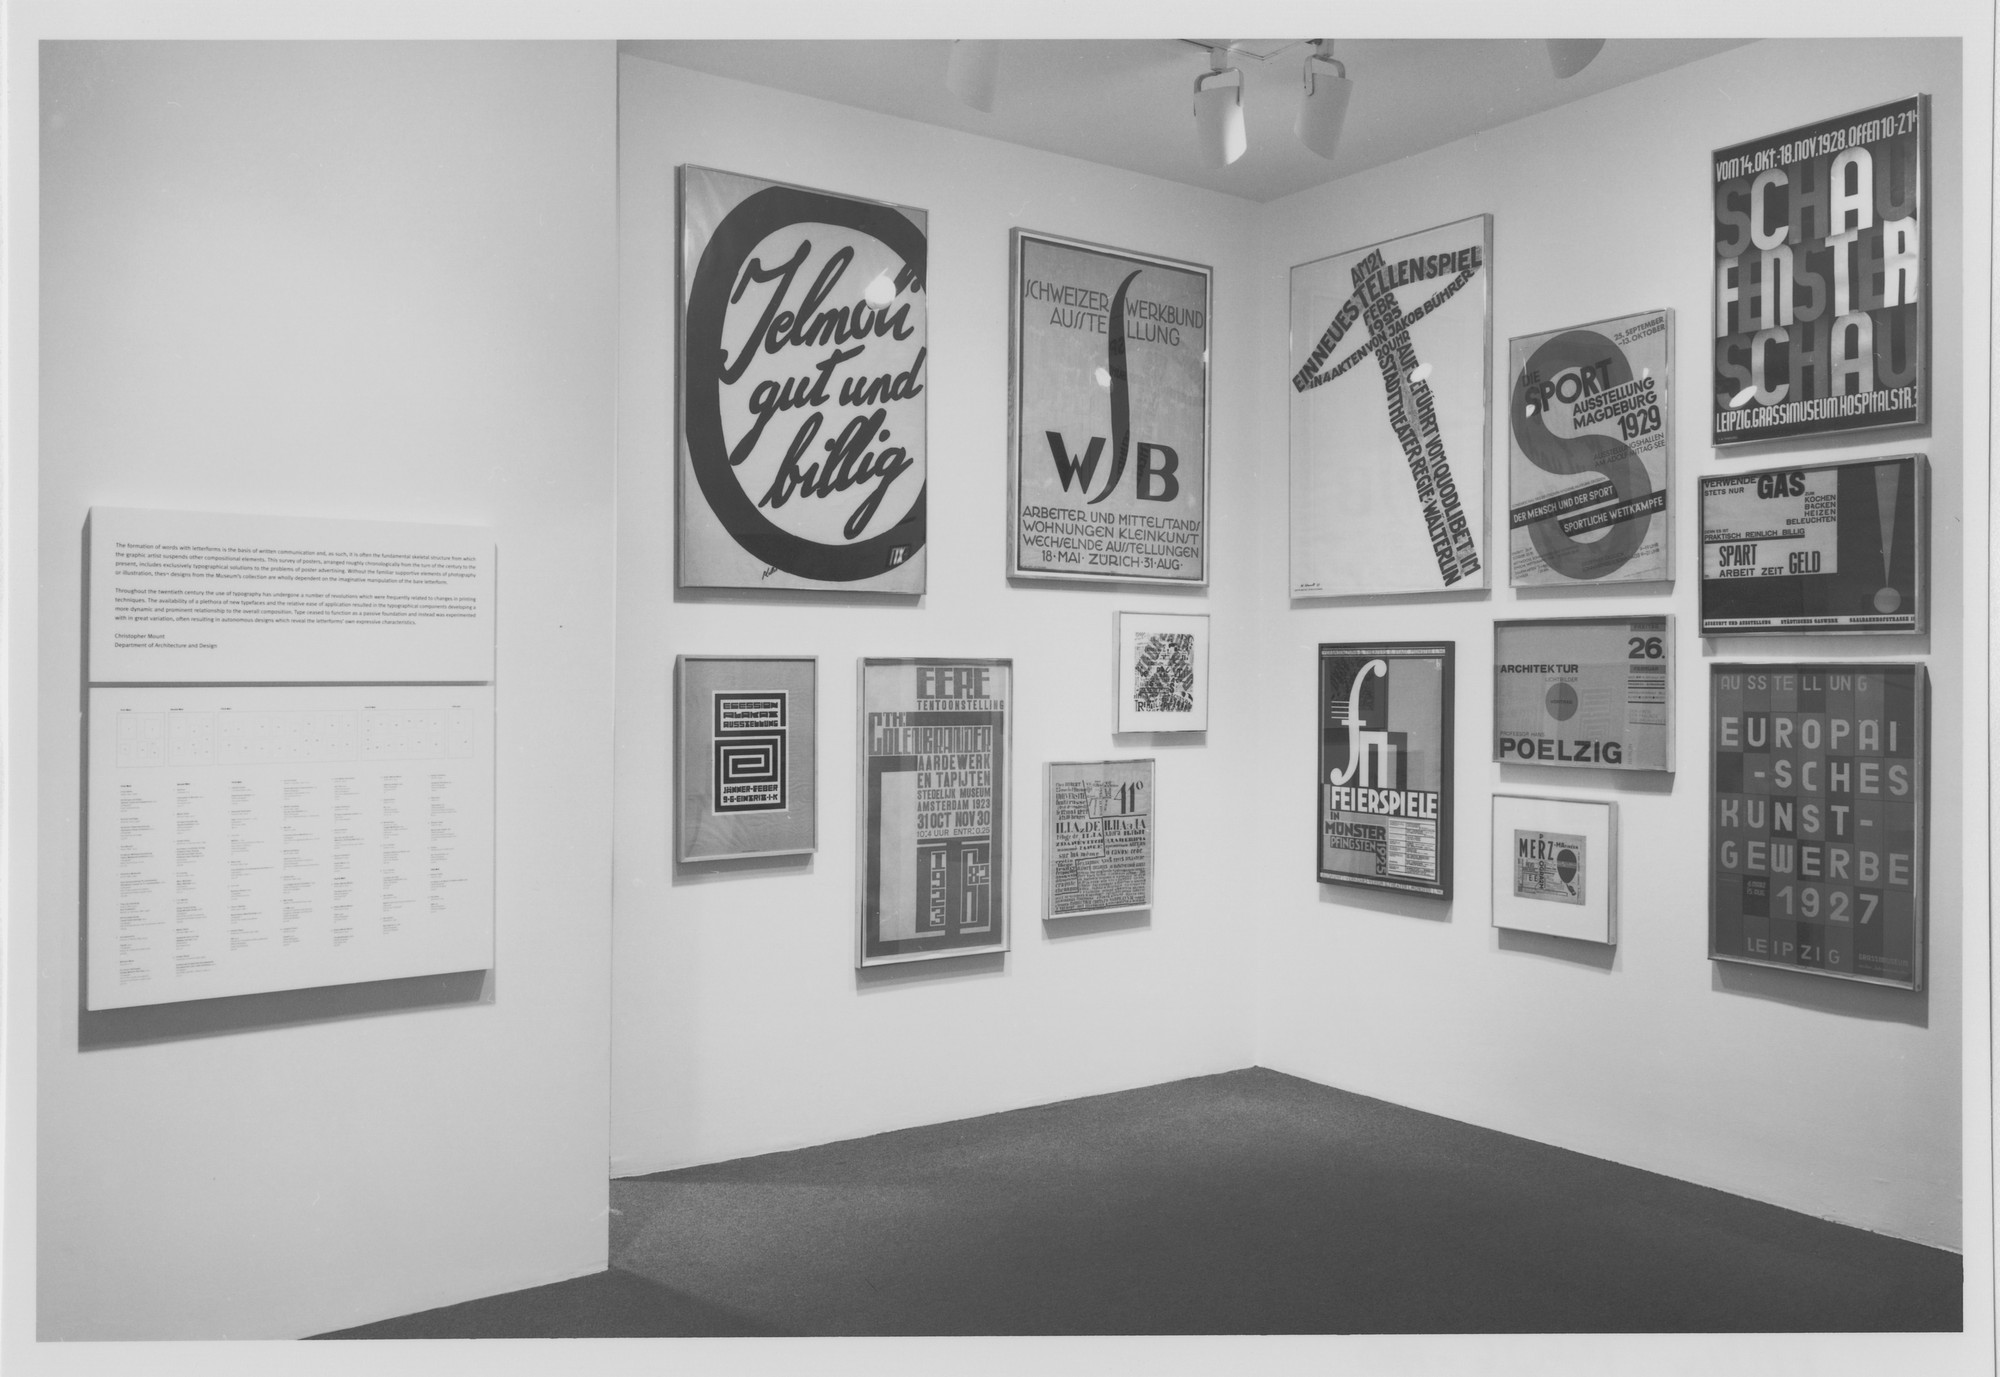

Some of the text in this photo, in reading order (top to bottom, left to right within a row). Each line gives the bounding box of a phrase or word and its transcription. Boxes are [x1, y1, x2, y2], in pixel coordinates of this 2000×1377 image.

[1716, 142, 1917, 258] SCHAU
[1716, 216, 1918, 338] FENSTER
[1025, 279, 1204, 329] SCHWEIZER WERKBUND
[1388, 306, 1425, 341] JAKOB
[1423, 268, 1475, 315] BÜHRER
[1368, 305, 1402, 337] 1925
[1613, 316, 1664, 341] 25. SEPTEMBER
[1632, 323, 1665, 341] OKTOBER
[1716, 308, 1917, 411] SCHAU
[1522, 370, 1541, 387] DIE
[1525, 357, 1612, 417] SPORT
[729, 344, 926, 466] gut und
[1573, 376, 1654, 416] AUSSTELLUNG
[1573, 390, 1657, 429] MAGDEBURG
[1617, 405, 1661, 441] 1929
[1425, 433, 1447, 468] VOM
[757, 407, 914, 541] billig
[1704, 472, 1806, 499] VERWENDE GAS
[1433, 462, 1475, 551] QUODLIBET
[1513, 509, 1526, 523] DER
[1528, 503, 1557, 518] MENSCH
[1558, 498, 1573, 510] UND
[1574, 494, 1588, 505] DER
[1589, 485, 1613, 500] SPORT
[1804, 495, 1836, 503] KOCHEN
[1804, 502, 1836, 510] BACKEN
[1022, 506, 1201, 531] ARBEITER UND MITTELSTANDS
[1564, 496, 1664, 532] SPORTLICHE WETTKÄMPFE
[1786, 516, 1836, 526] BELEUCHTEN
[1804, 509, 1836, 517] HEIZEN
[1023, 520, 1199, 545] WOHNUNGEN KLEINKUNST
[1704, 528, 1805, 541] PRAKTISCH REINLICH BILLIG
[1022, 534, 1199, 558] WECHSELNDE AUSSTELLUNGEN
[1460, 552, 1482, 577] IM
[1719, 544, 1820, 574] SPART GELD
[1719, 567, 1784, 578] ARBEIT ZEIT
[114, 641, 147, 649] Department
[1627, 636, 1665, 659] 26.
[1500, 664, 1579, 673] ARCHITEKTUR
[916, 667, 990, 699] EERE
[1721, 674, 1868, 693] AUSSTELLUNG
[917, 700, 1004, 711] TENTOONSTELLING
[1721, 716, 1897, 752] EUROPÄI
[918, 754, 991, 771] AARDEWERK
[1500, 738, 1622, 764] POELZIG
[917, 771, 991, 789] EN TAPIJTEN
[917, 787, 991, 800] STEDELIJK MUSEUM
[917, 799, 991, 812] AMSTERDAM 1923
[1331, 786, 1438, 819] FEIERSPIELE
[1331, 811, 1340, 821] IN
[934, 829, 949, 837] UUR
[1325, 820, 1387, 841] MÜNSTER
[1331, 836, 1376, 853] PFINGSTEN
[1519, 838, 1554, 860] MERZ
[1376, 840, 1387, 875] 1925
[1721, 840, 1909, 886] GEWERBE
[1776, 885, 1879, 925] 1927
[1747, 937, 1840, 964] LEIPZIG
